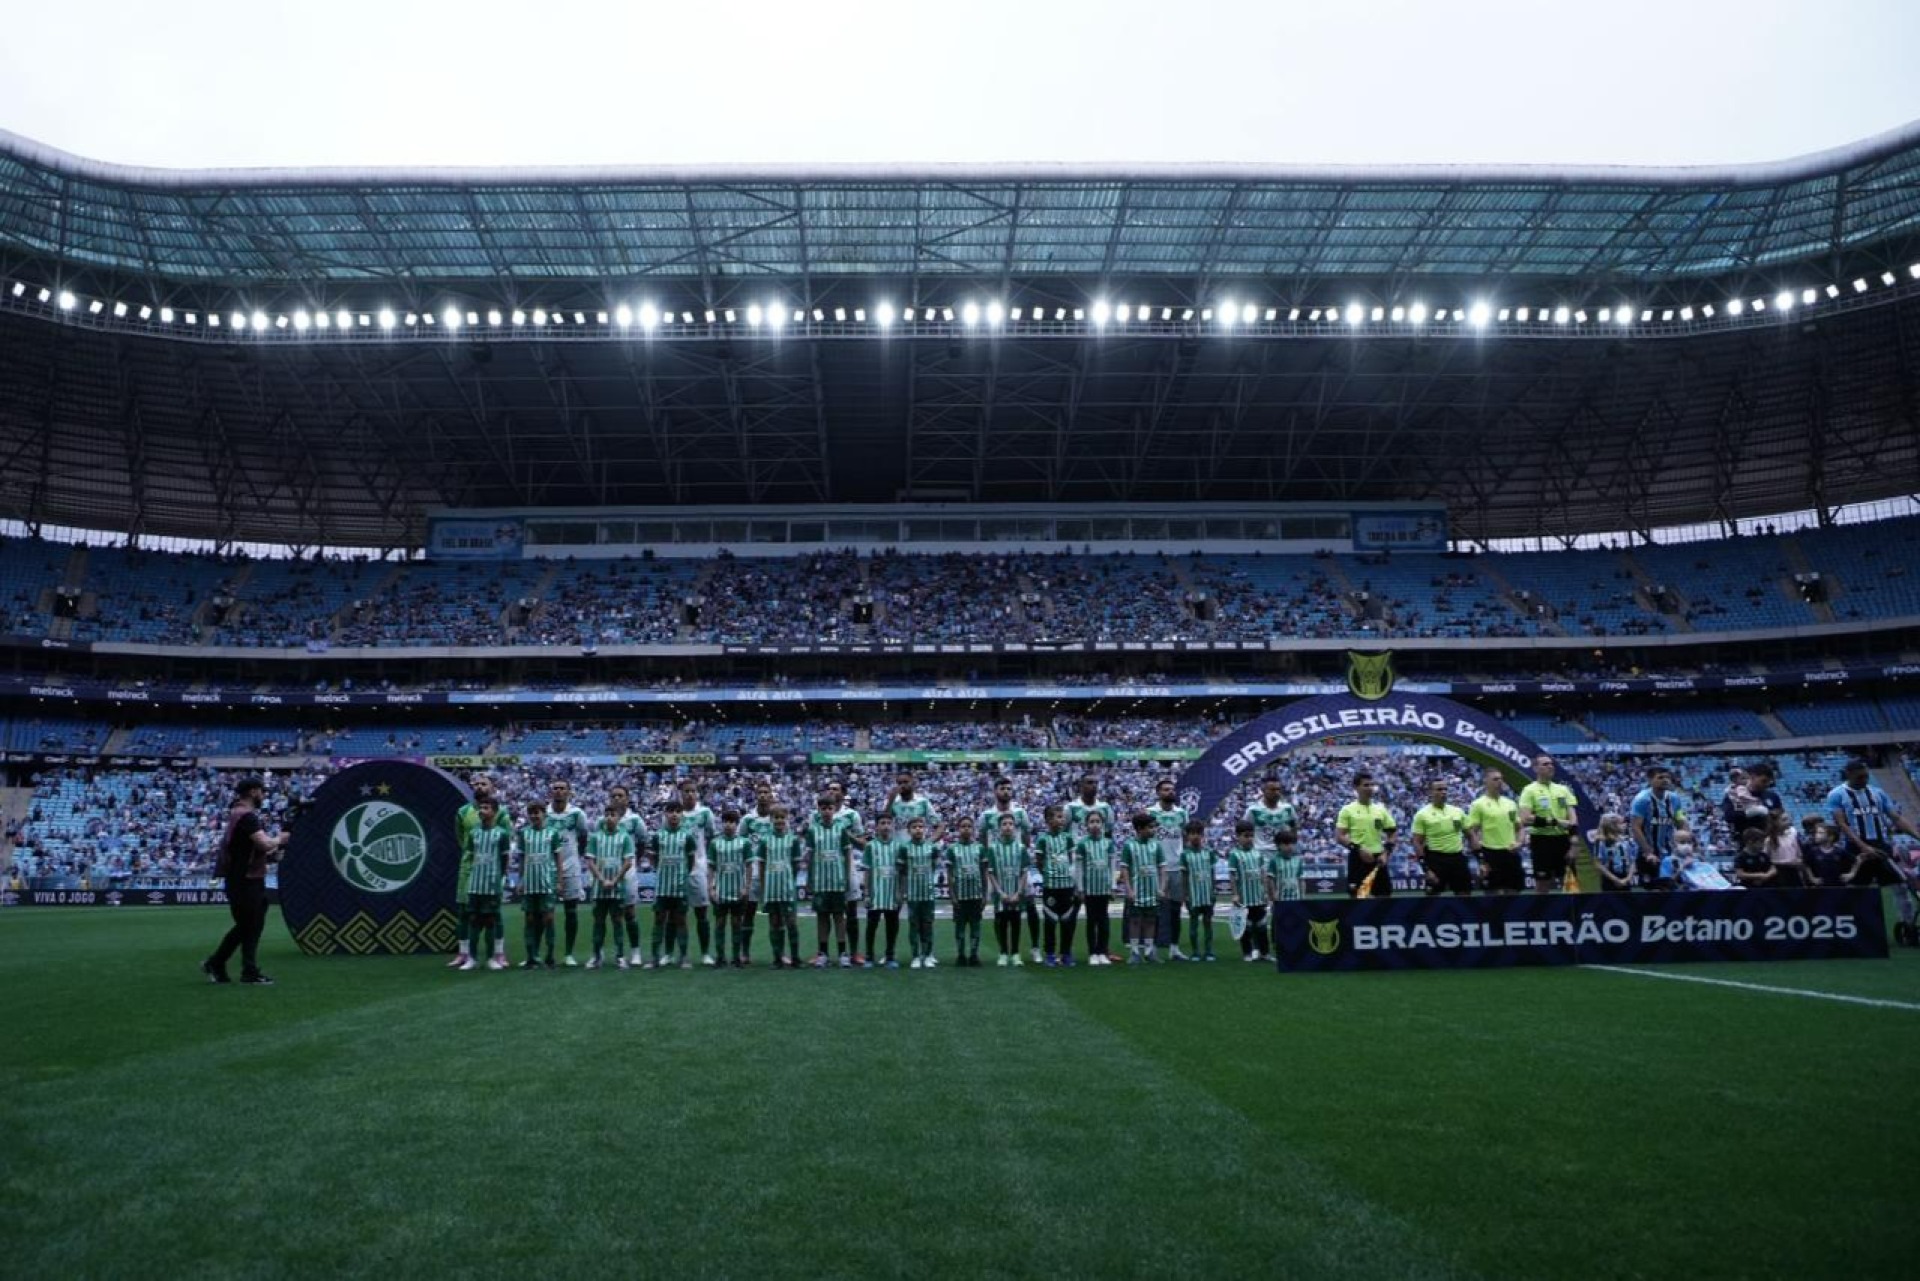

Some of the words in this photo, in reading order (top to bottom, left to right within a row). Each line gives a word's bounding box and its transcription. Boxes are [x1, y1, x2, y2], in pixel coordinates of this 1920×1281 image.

[1222, 704, 1445, 775] BRASILEIRÃO
[1455, 719, 1532, 768] Betano
[34, 891, 57, 904] VIVA
[58, 891, 66, 904] O
[67, 891, 96, 904] JOGO
[176, 891, 199, 903] VIVA
[1353, 913, 1630, 950] BRASILEIRÃO
[1641, 914, 1754, 943] Betano
[1764, 914, 1858, 941] 2025
